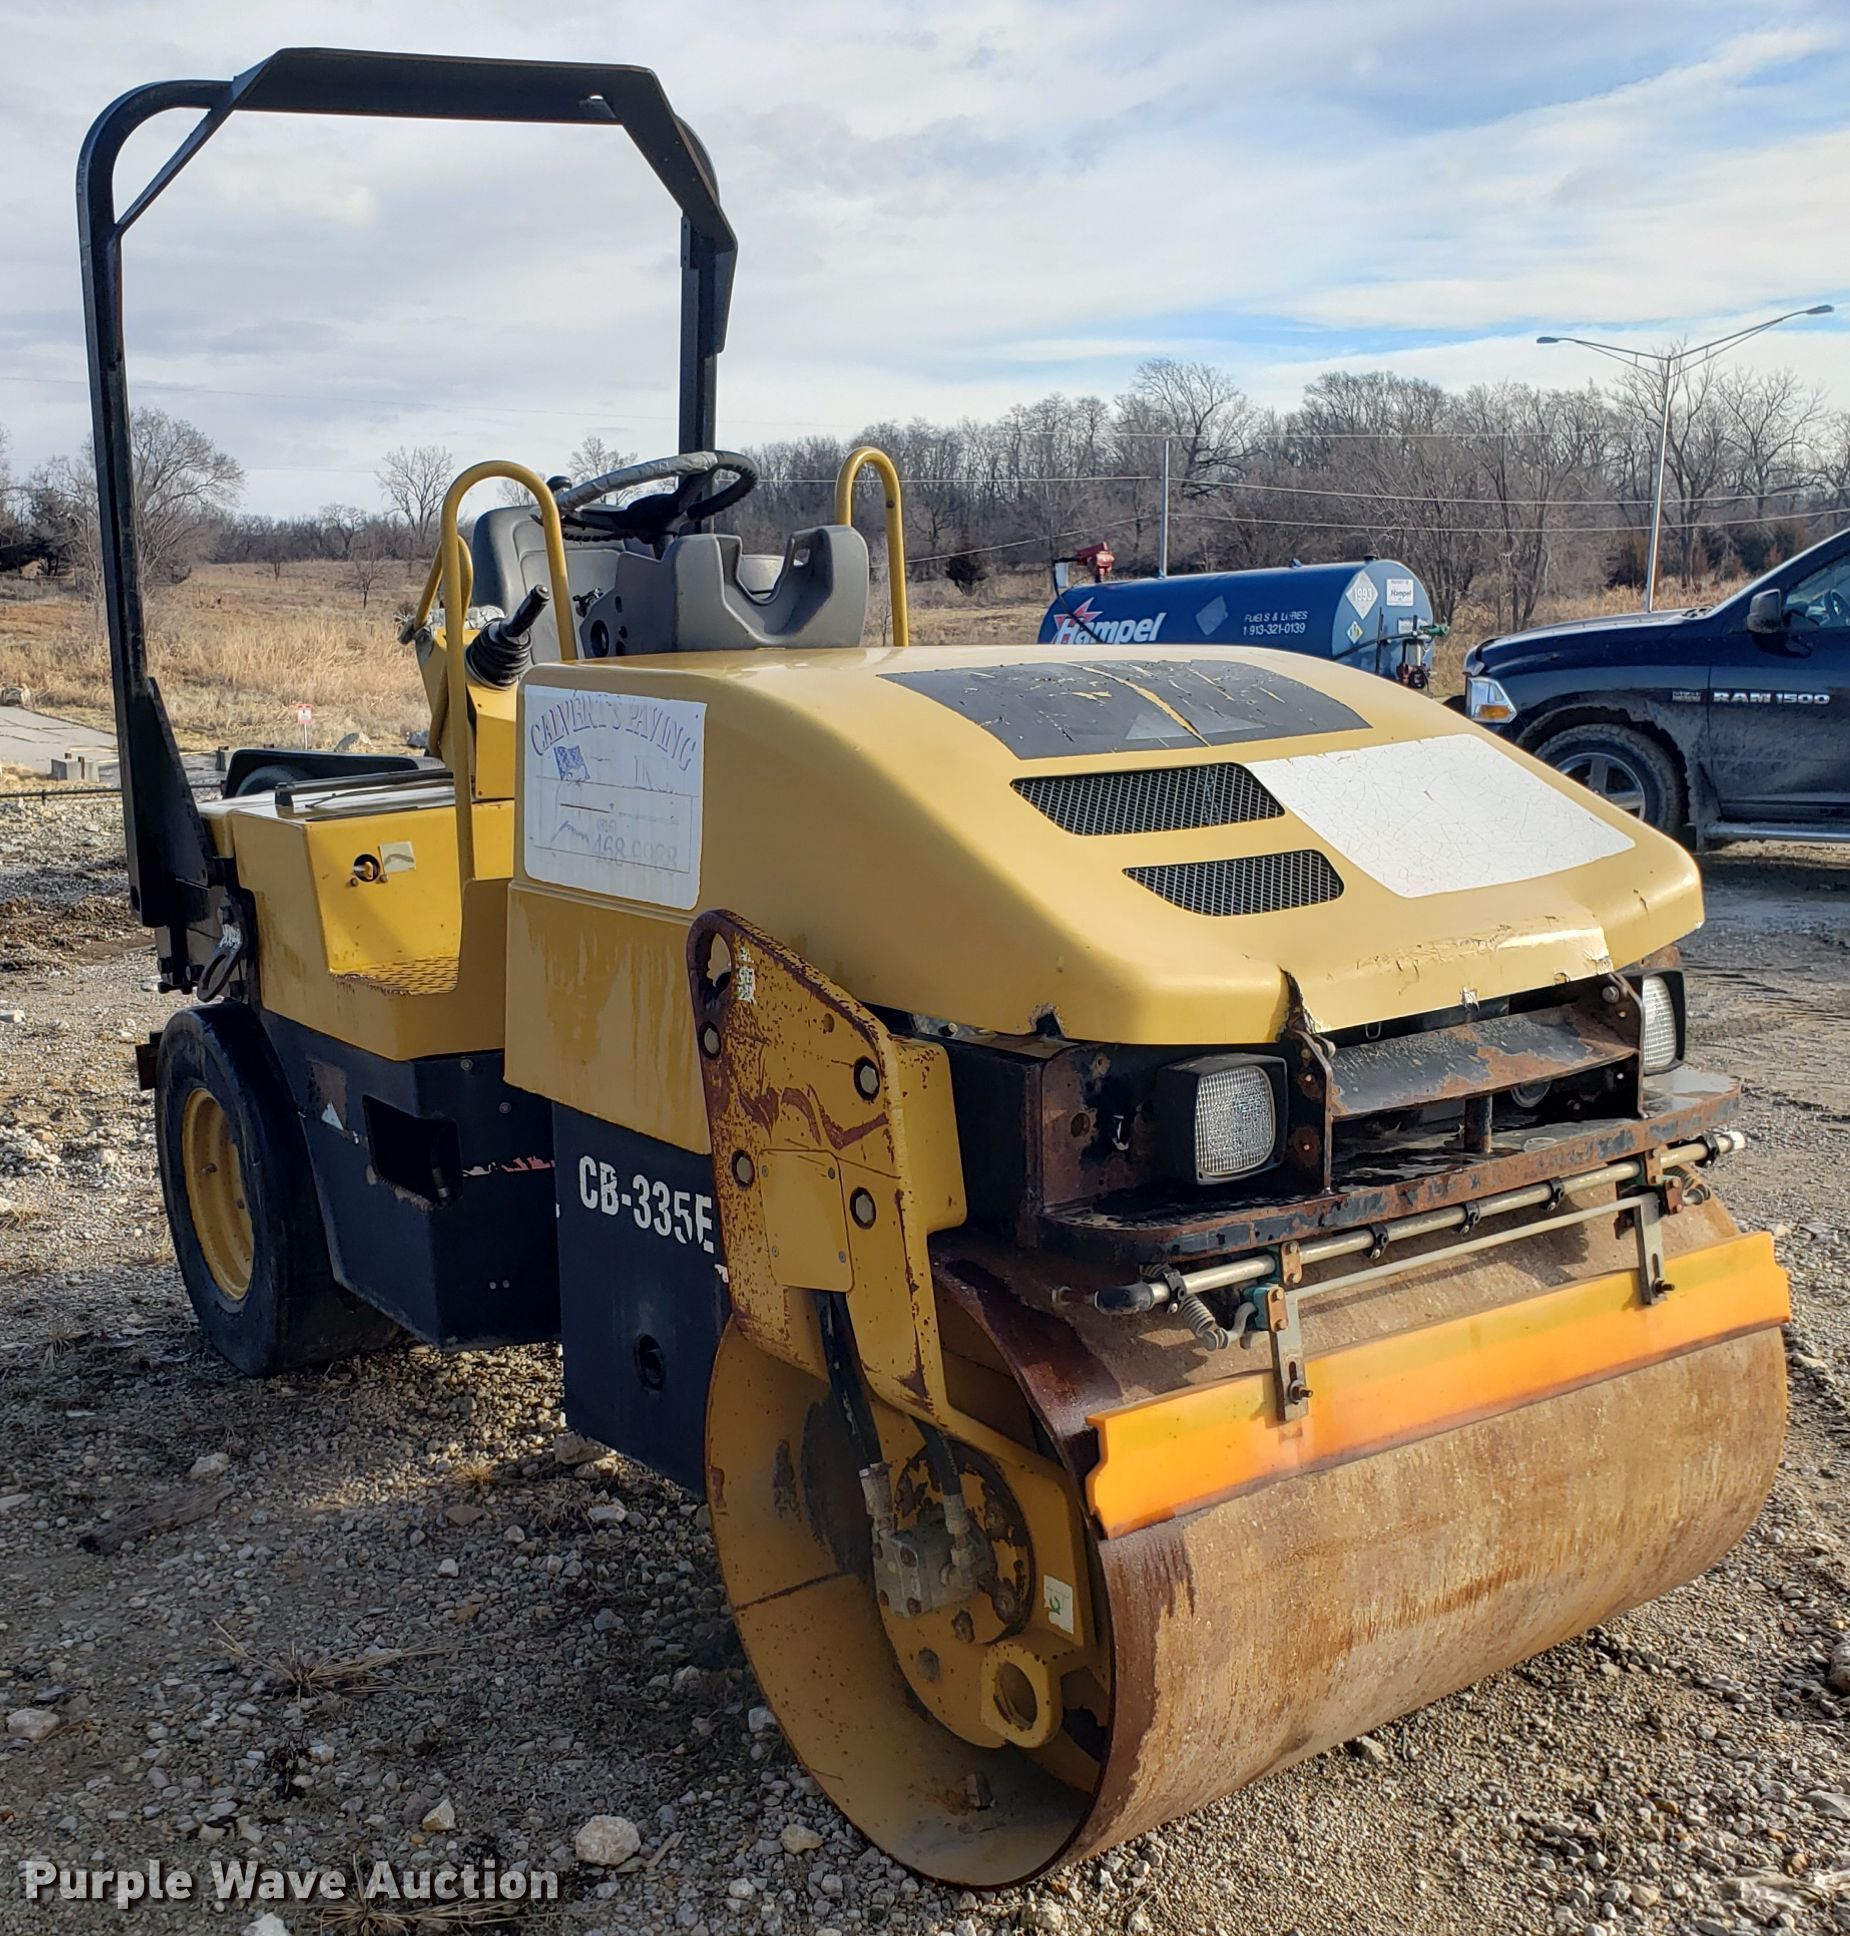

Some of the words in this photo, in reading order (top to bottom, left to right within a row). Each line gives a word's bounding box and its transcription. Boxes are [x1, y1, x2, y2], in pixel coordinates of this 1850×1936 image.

[1354, 587, 1373, 601] 1993
[1055, 612, 1167, 645] Hampel
[1713, 692, 1771, 704] RAM
[1775, 693, 1831, 705] 1500
